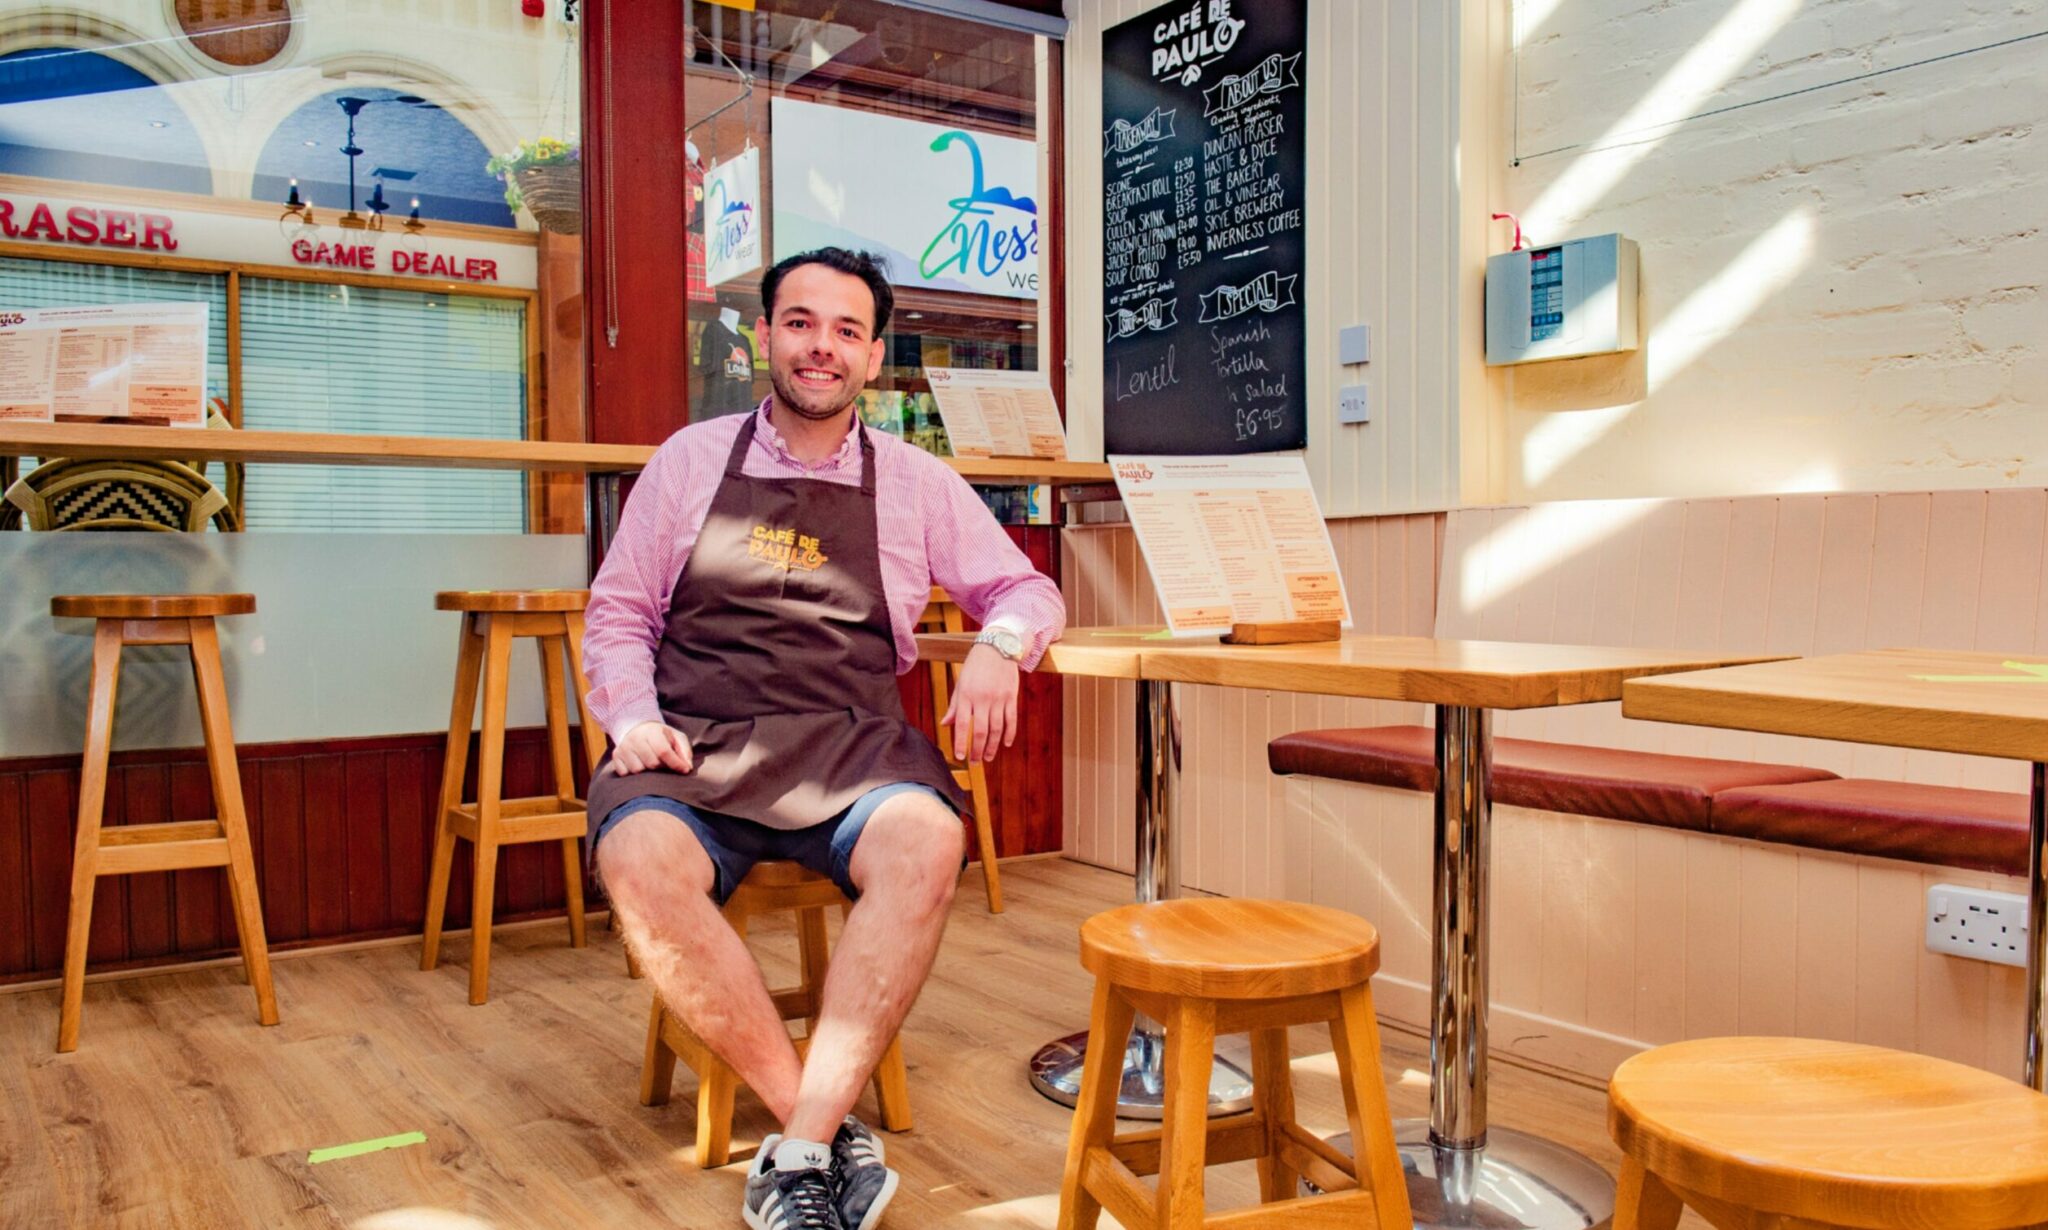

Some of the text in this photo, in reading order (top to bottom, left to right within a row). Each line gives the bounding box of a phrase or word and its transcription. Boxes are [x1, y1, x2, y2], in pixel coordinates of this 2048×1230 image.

[1153, 0, 1231, 44] CAFÉ DE
[1152, 17, 1246, 77] PAULO
[1227, 57, 1279, 108] ABOUT US
[1203, 113, 1285, 162] DUNCAN FRASER
[1204, 137, 1278, 180] HASTIE & DYCE
[1204, 159, 1265, 197] THE BAKERY
[1106, 175, 1133, 198] SCONE
[1106, 175, 1172, 213] BREAKFAST ROLL
[1204, 173, 1282, 214] OIL & VINEGAR
[1106, 207, 1128, 227] SOUP
[1106, 208, 1166, 242] CULLEN SKINK
[1204, 189, 1285, 234] SKYE BREWERY
[1206, 208, 1301, 253] INVERNESS COFFEE
[291, 238, 498, 282] GAME DEALER
[1105, 260, 1160, 288] SOUP COMBO
[1107, 242, 1167, 271] JACKET POTATO
[1223, 274, 1274, 316] SPECIAL
[1211, 320, 1271, 360] Spanish
[1115, 343, 1179, 401] Lentil
[748, 538, 829, 570] PAULO
[752, 525, 820, 550] CAFÉ DE
